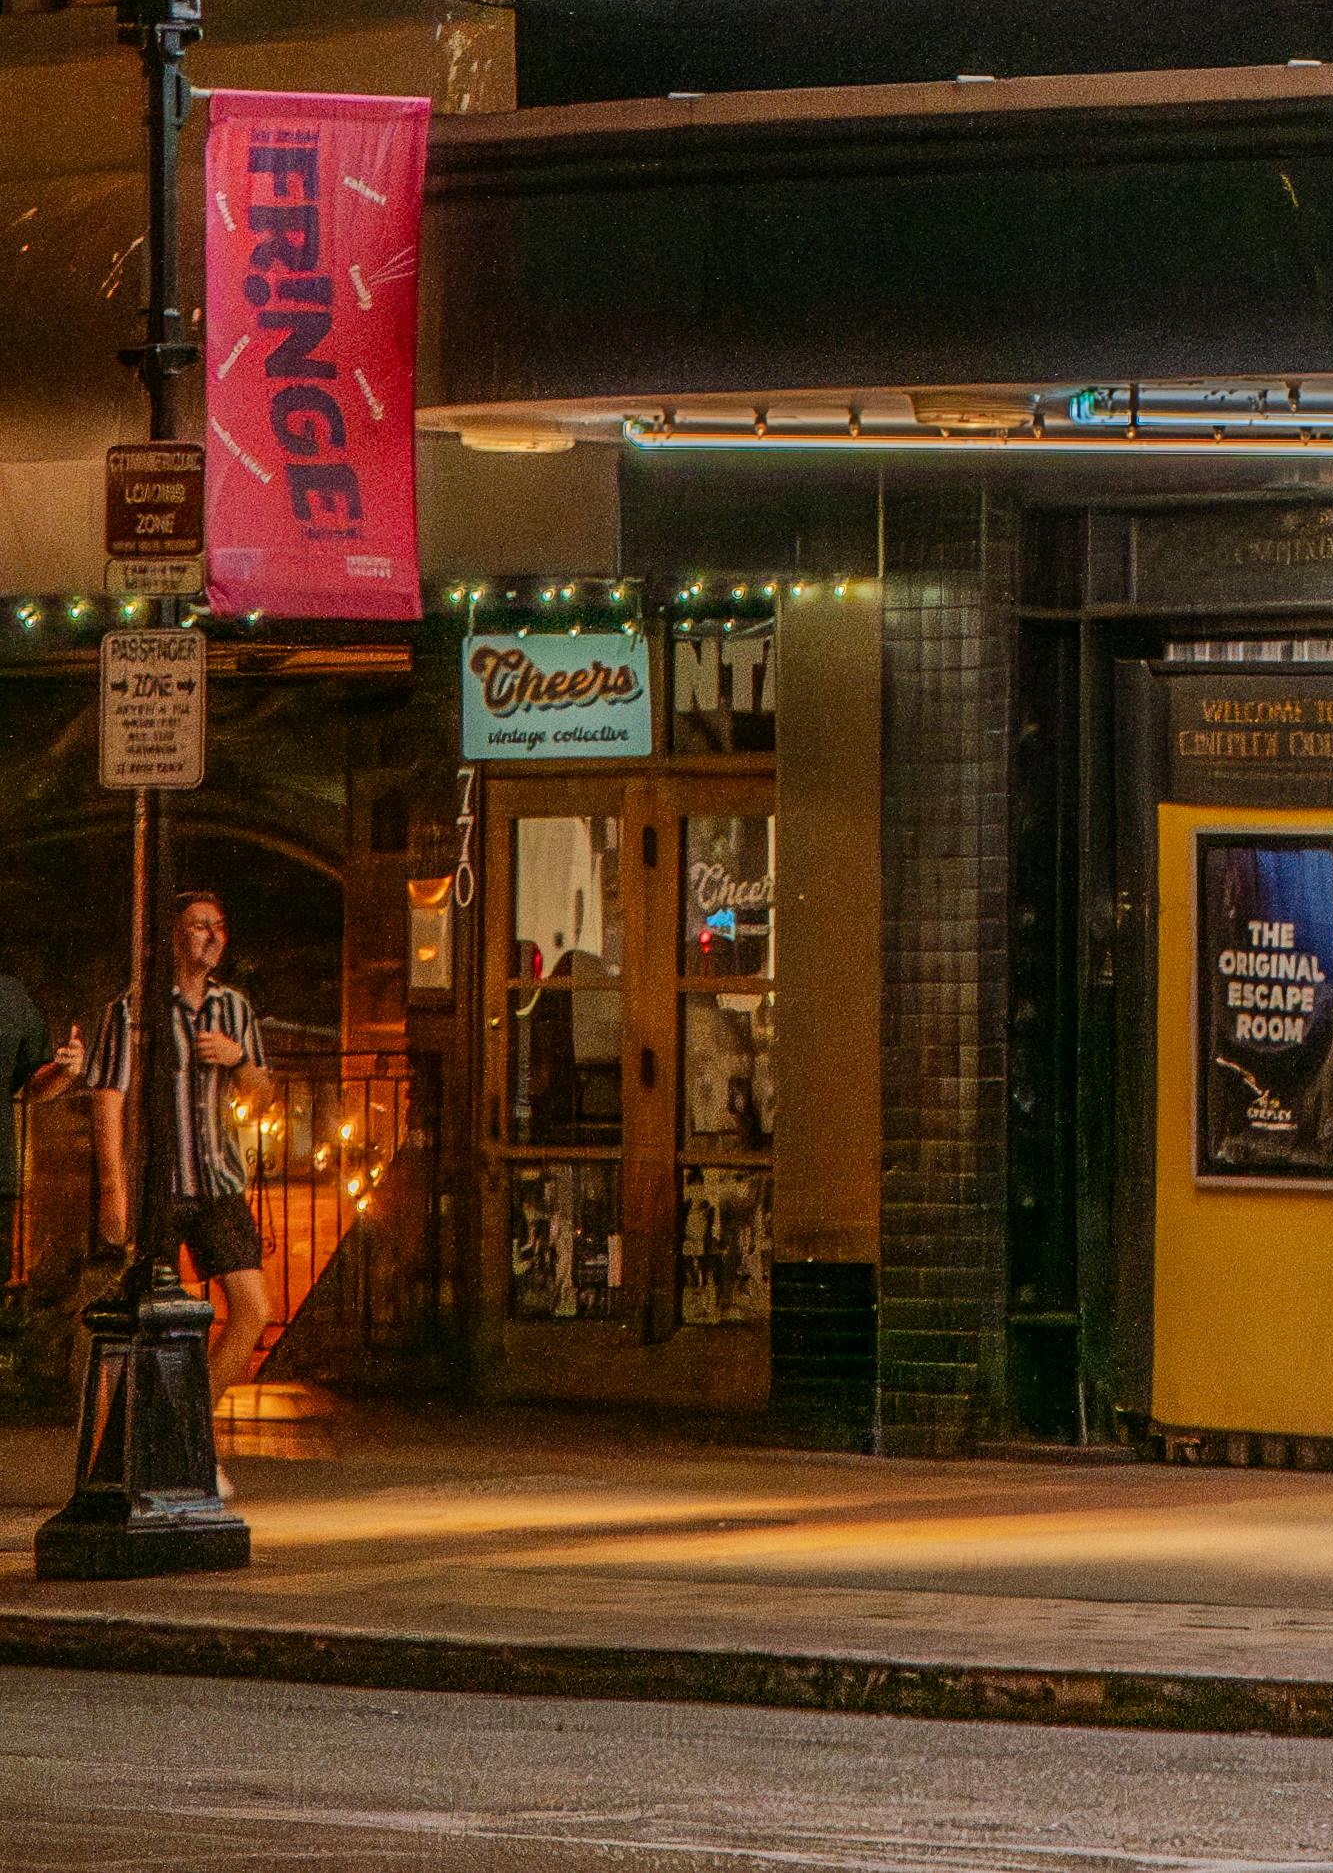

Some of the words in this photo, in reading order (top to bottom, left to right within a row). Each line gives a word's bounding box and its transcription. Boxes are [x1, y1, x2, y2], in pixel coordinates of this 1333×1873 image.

[136, 512, 176, 534] ZONE
[111, 638, 197, 661] PASSENGER
[133, 673, 173, 697] ZONE
[469, 644, 642, 718] Cheers
[1202, 700, 1302, 723] WELCOME
[488, 728, 545, 751] vintage
[553, 727, 629, 743] collective
[456, 768, 475, 907] 770
[1248, 920, 1295, 948] THE
[1218, 950, 1325, 983] ORIGINAL
[1227, 981, 1315, 1013] ESCAPE
[1236, 1012, 1304, 1044] ROOM
